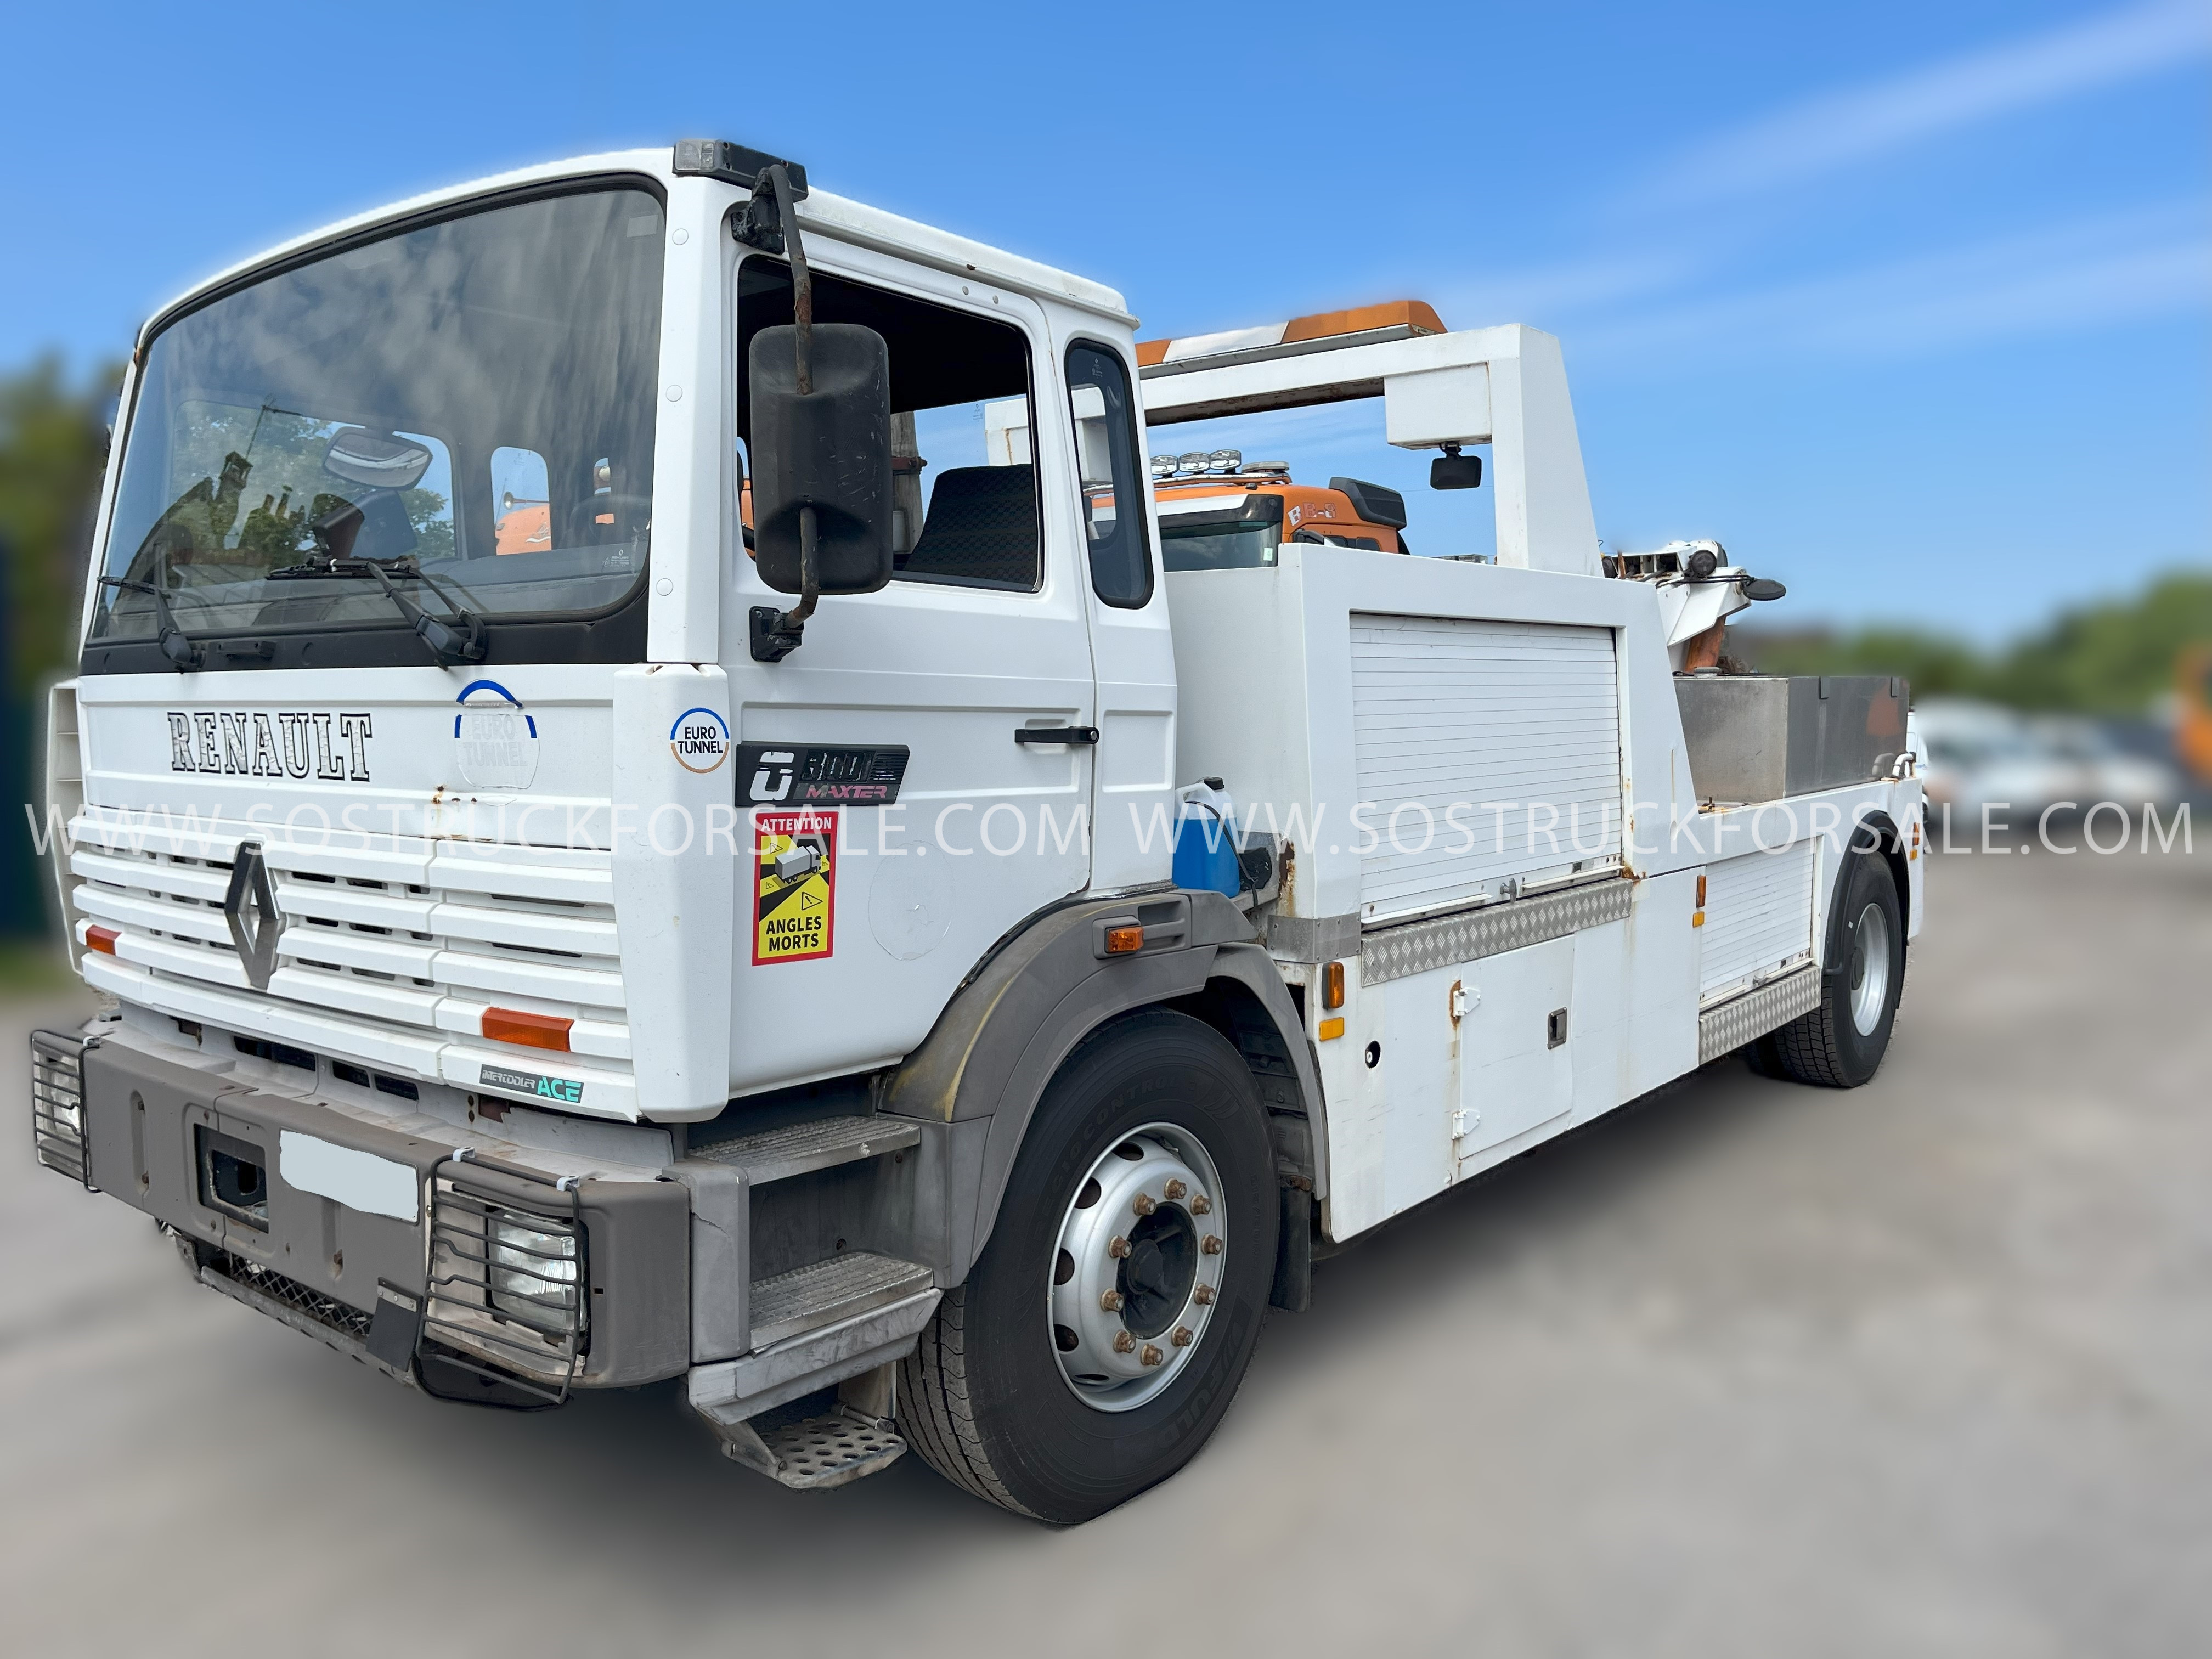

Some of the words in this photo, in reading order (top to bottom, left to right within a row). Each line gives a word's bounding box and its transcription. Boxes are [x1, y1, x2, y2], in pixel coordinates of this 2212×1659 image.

[471, 714, 516, 740] EURO
[684, 726, 716, 740] EURO
[167, 712, 373, 782] RENAULT
[462, 742, 528, 766] TUNNEL
[678, 741, 723, 754] TUNNEL
[806, 785, 888, 799] MAXTER
[761, 817, 832, 832] ATTENTION
[765, 915, 822, 935] ANGLES
[769, 933, 819, 952] MORTS
[537, 1076, 582, 1102] ACE
[1032, 1076, 1178, 1242] REGIOCONTROL
[1127, 1359, 1224, 1457] FULD
